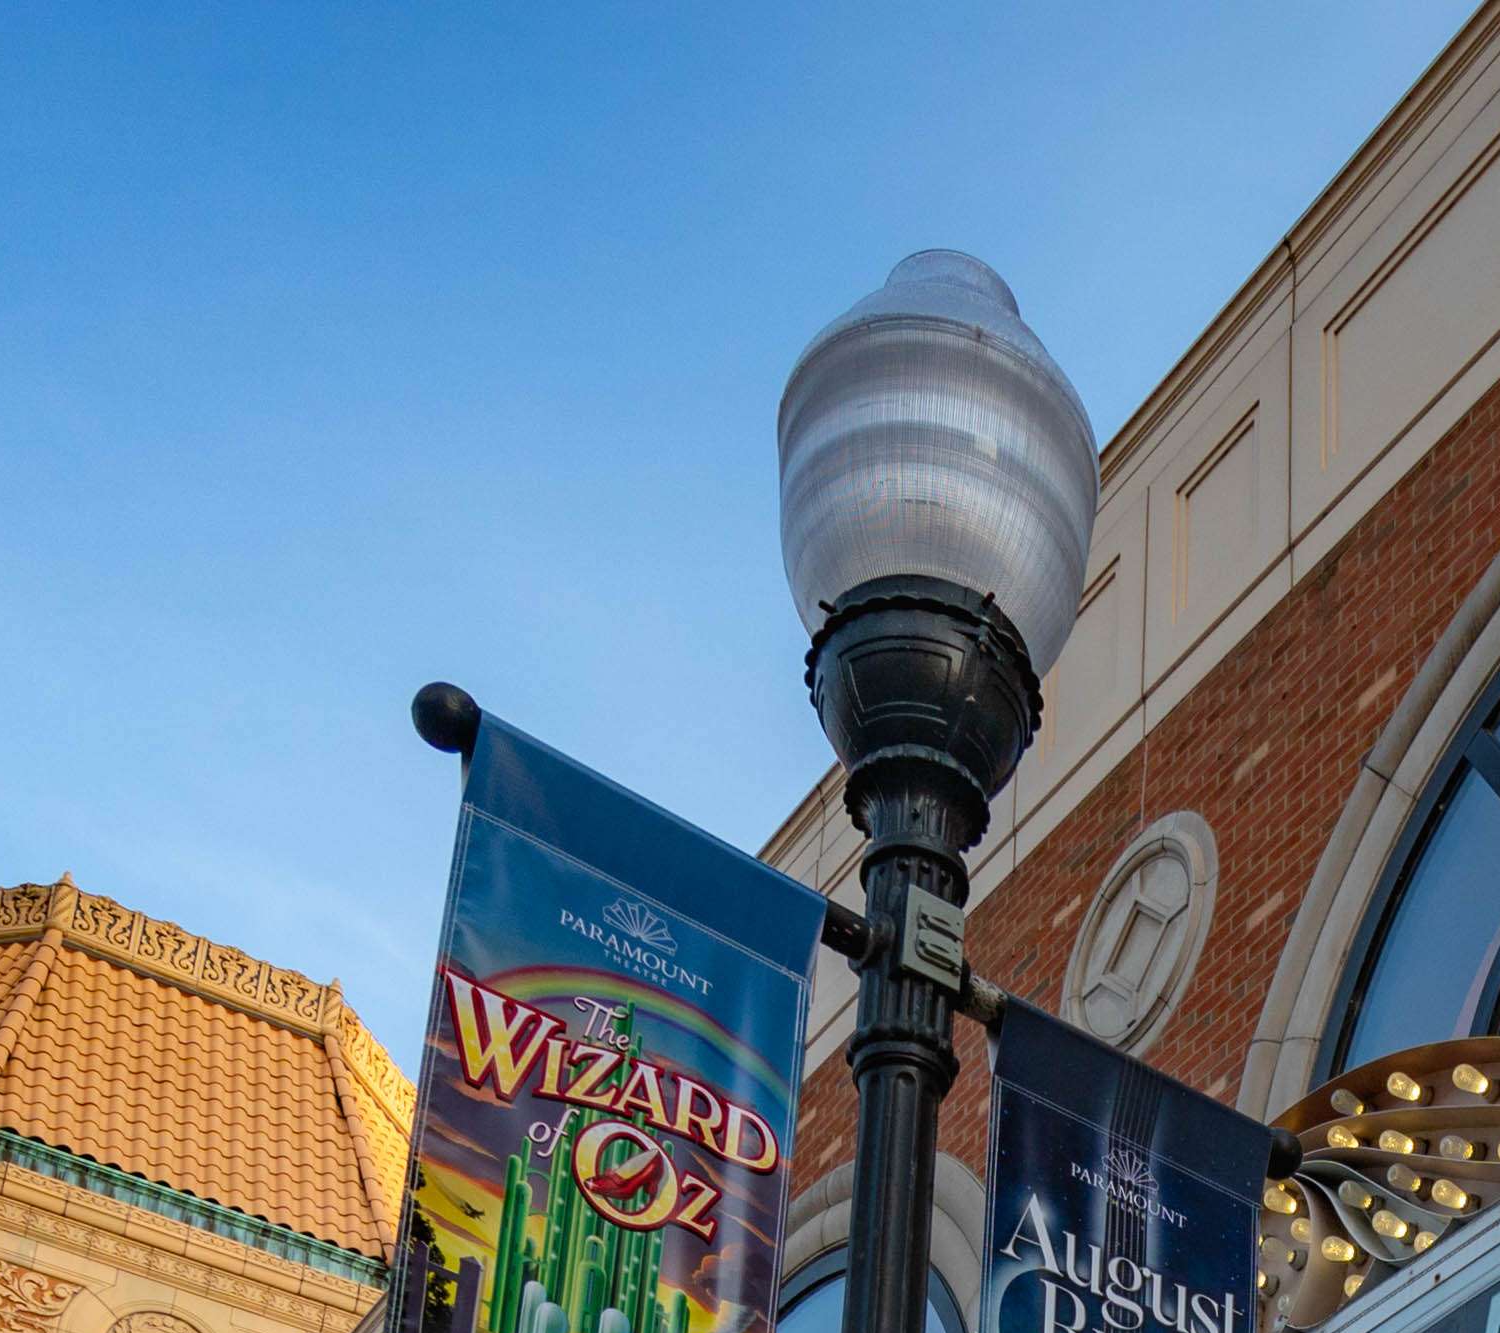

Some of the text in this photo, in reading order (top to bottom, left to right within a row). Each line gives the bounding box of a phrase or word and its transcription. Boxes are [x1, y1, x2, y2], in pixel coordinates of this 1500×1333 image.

[560, 909, 713, 995] PARAMOUNT
[604, 948, 668, 987] THEATRE
[574, 996, 631, 1052] The
[440, 966, 780, 1174] WIZARD
[528, 1108, 580, 1158] of
[1070, 1162, 1188, 1228] PARAMOUNT
